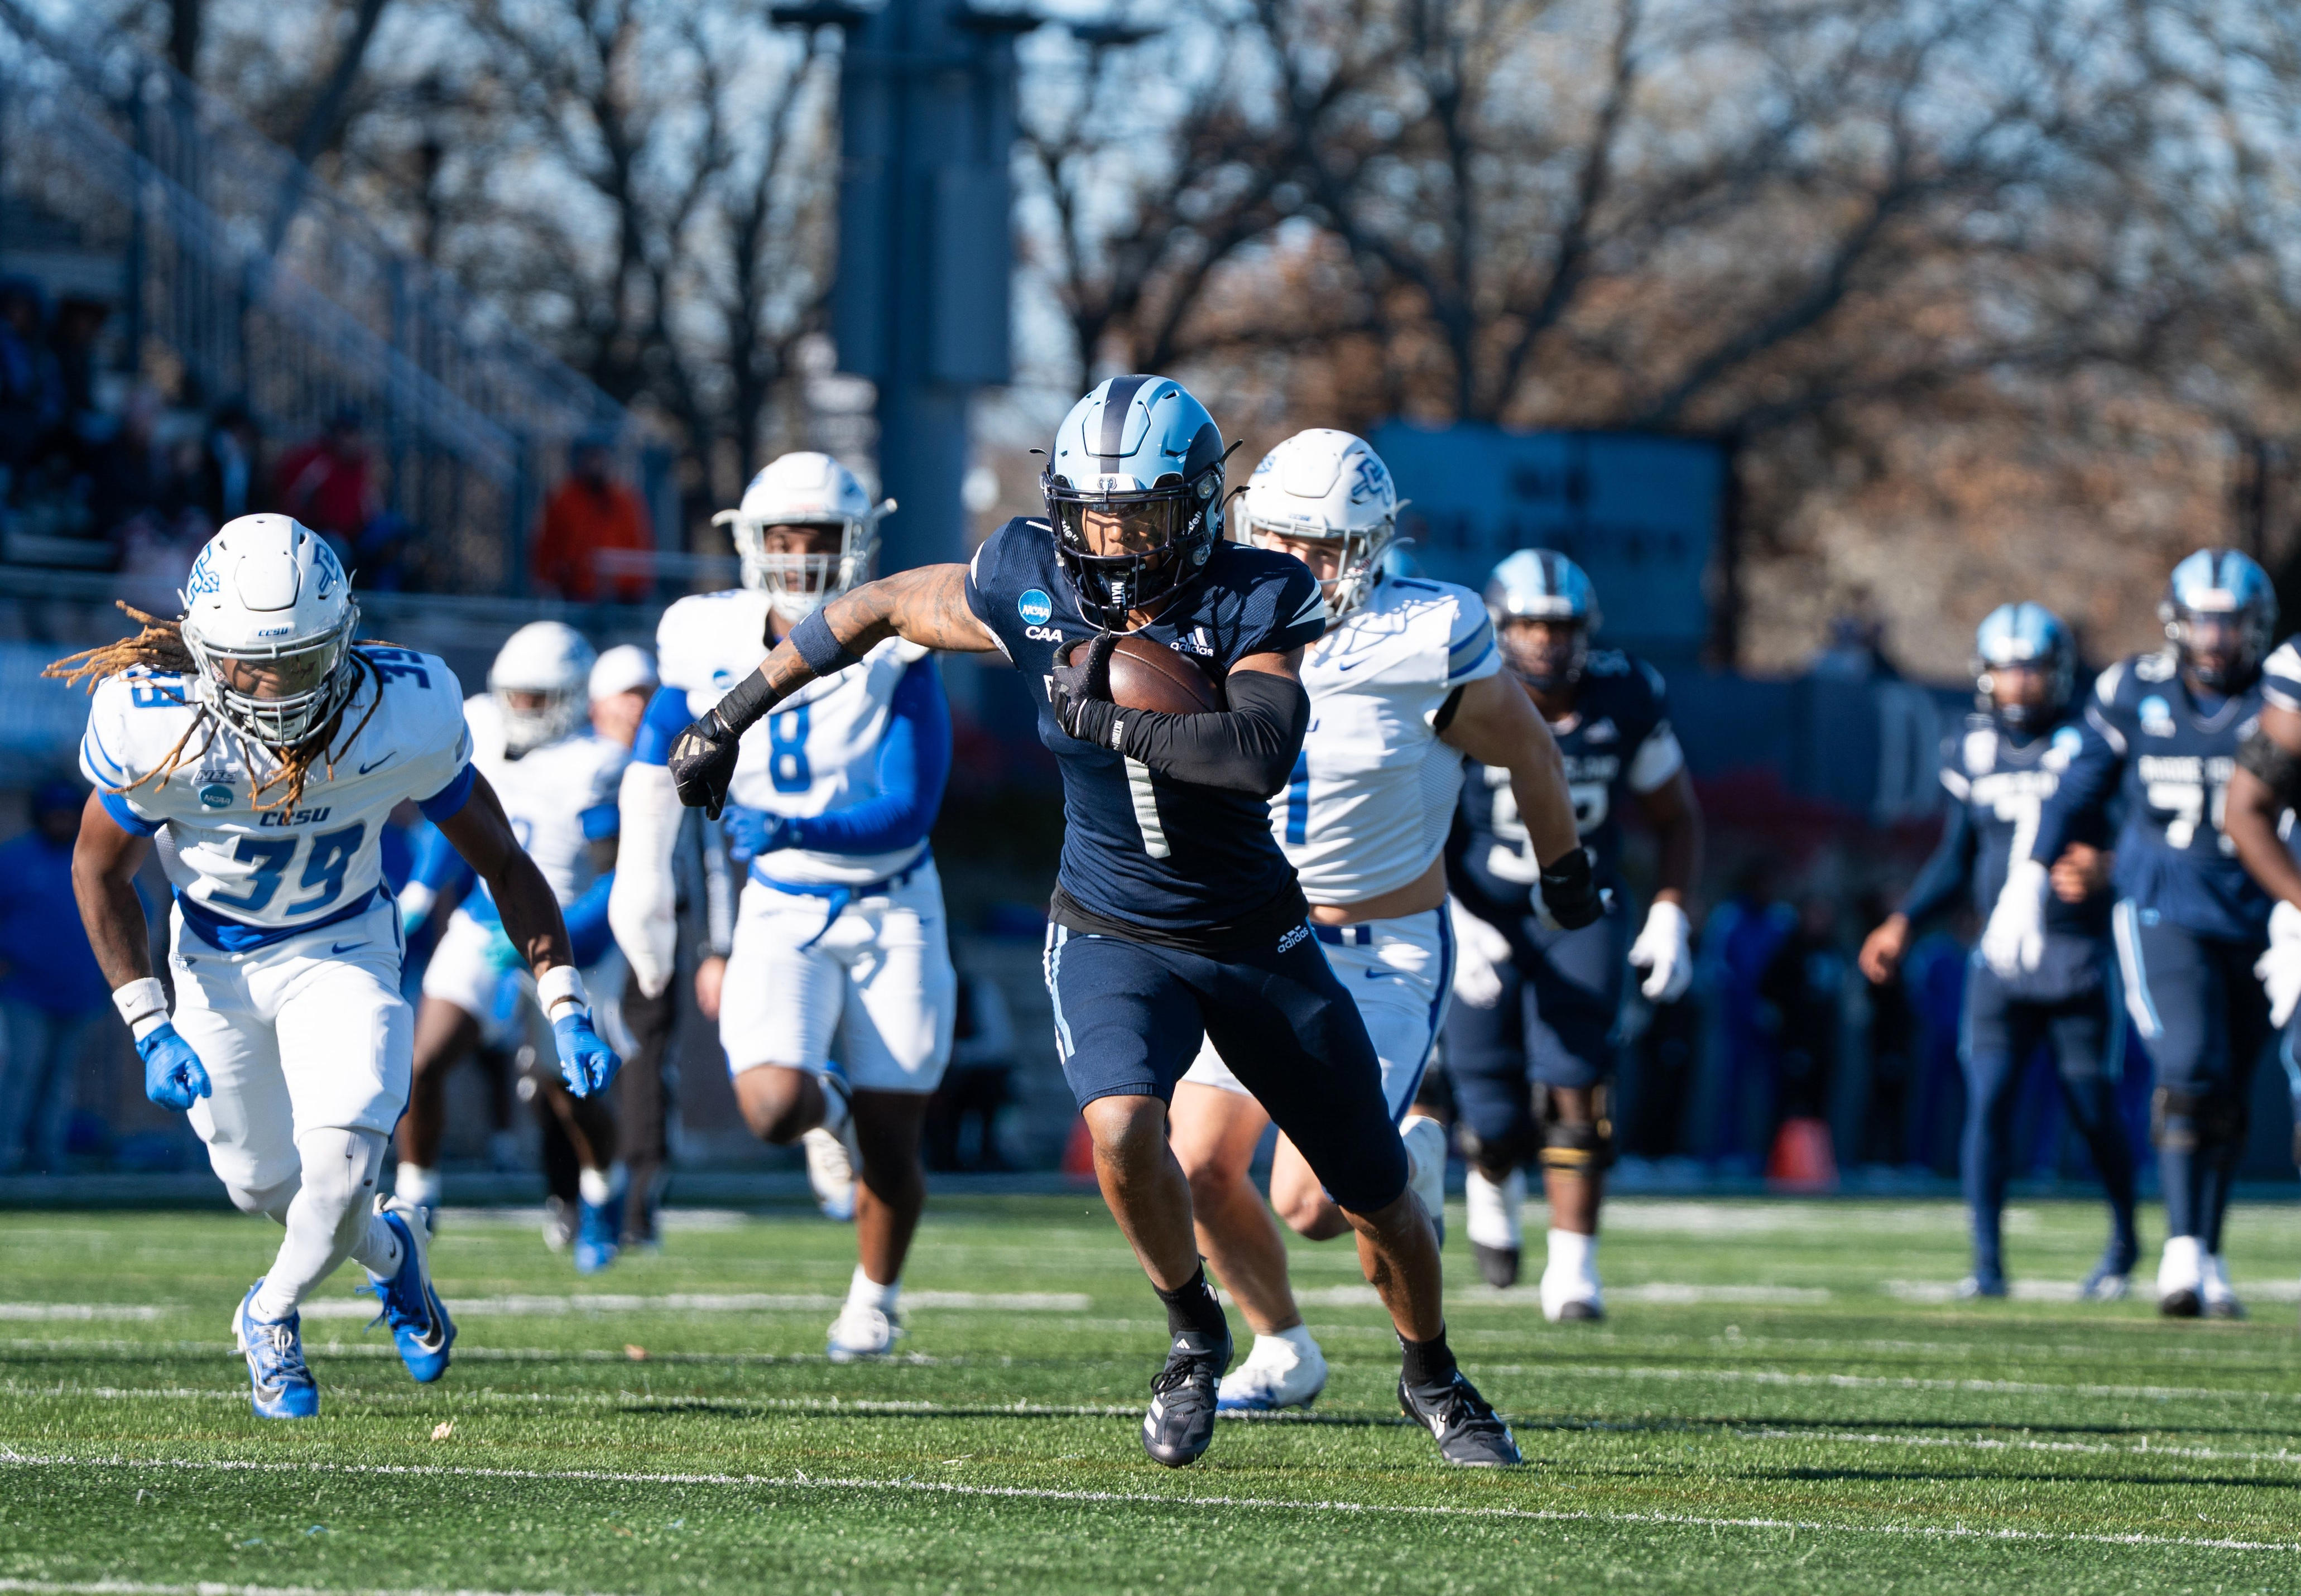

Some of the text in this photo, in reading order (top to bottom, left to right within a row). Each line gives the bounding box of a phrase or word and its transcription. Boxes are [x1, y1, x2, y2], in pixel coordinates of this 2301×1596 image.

[1022, 604, 1050, 618] NCAA
[257, 626, 289, 637] CCSU
[1025, 626, 1063, 642] CAA
[1170, 642, 1214, 657] adidas
[768, 704, 812, 793] 8
[203, 794, 231, 805] NCAA
[259, 807, 332, 827] CCSU
[206, 819, 367, 918] 39
[1277, 927, 1309, 953] adidas
